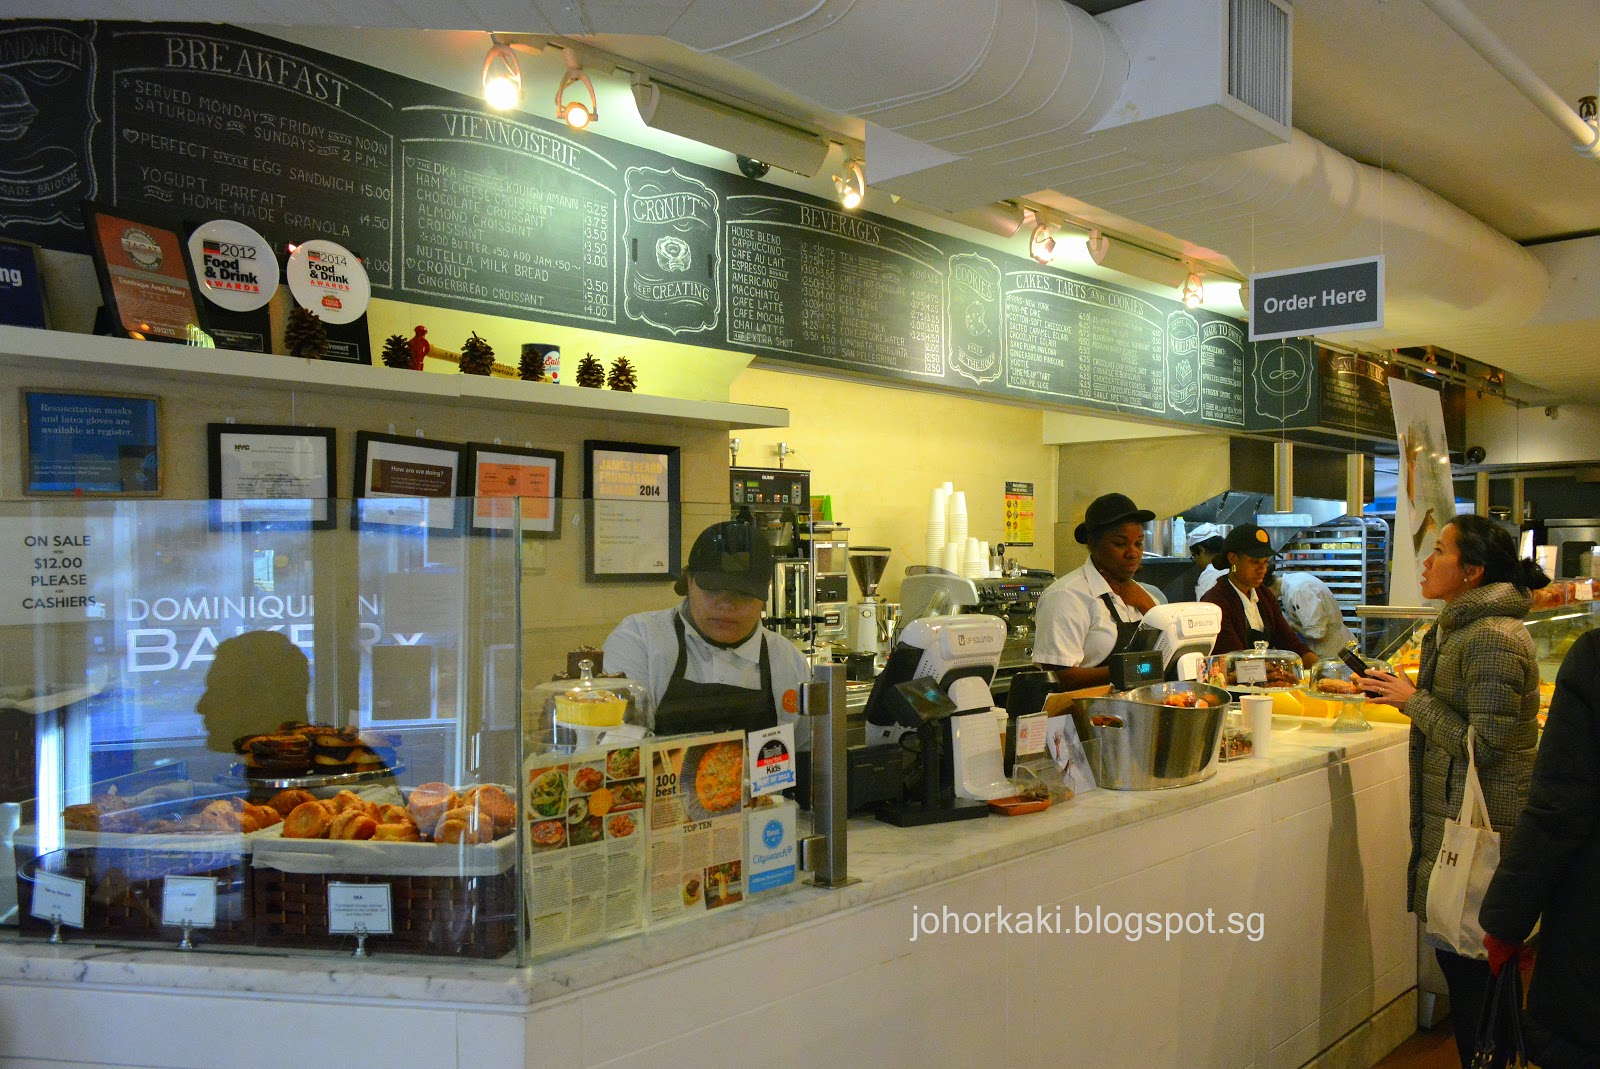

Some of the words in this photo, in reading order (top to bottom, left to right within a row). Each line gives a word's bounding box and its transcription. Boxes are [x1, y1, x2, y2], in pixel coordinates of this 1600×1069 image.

[165, 37, 349, 108] BREAKFAST
[135, 79, 191, 106] SERVED
[199, 97, 259, 124] MONDAY
[279, 117, 326, 140] FRIDAY
[356, 135, 388, 156] NOON
[135, 97, 223, 131] SATURDAYS
[254, 126, 316, 153] SUNDAYS
[342, 150, 351, 162] 2
[443, 113, 581, 171] VIENNOISERIE
[140, 132, 209, 160] PERFECT
[253, 159, 282, 177] EGG
[289, 167, 354, 195] SANDWICH
[360, 184, 391, 201] $5.00
[37, 168, 80, 195] BRIOCHE
[140, 165, 208, 193] YOGURT
[221, 183, 287, 208] PARFAIT
[433, 162, 457, 179] DKA
[546, 192, 579, 210] AMANN
[416, 172, 440, 189] HAM
[452, 181, 490, 203] CHEESE
[495, 193, 556, 217] CROISSANT
[416, 188, 481, 214] CHOCOLATE
[487, 204, 546, 228] CROISSANT
[284, 213, 350, 238] GRANOLA
[418, 203, 468, 224] ALMOND
[472, 214, 533, 237] CROISSANT
[418, 217, 486, 241] CROISSANT
[800, 206, 880, 245] BEVERAGES
[220, 243, 258, 262] 2012
[430, 233, 449, 247] ADD
[513, 250, 531, 263] ADD
[731, 237, 783, 257] CAPPUCCINO
[203, 254, 240, 272] Food
[308, 261, 336, 275] Food
[320, 253, 348, 267] 2014
[416, 244, 474, 266] NUTELLA
[480, 258, 509, 274] MILK
[514, 263, 549, 282] BREAD
[731, 259, 767, 276] ESPRESSO
[754, 252, 766, 265] AU
[767, 257, 786, 271] LAIT
[204, 265, 217, 279] &
[219, 267, 259, 286] Drink
[309, 269, 320, 280] &
[320, 270, 349, 286] Drink
[731, 273, 779, 290] AMERICANO
[955, 266, 992, 299] COOKIES
[205, 280, 260, 293] AWARDS
[310, 279, 351, 292] AWARDS
[417, 273, 489, 297] GINGERBREAD
[492, 286, 544, 307] CROISSANT
[633, 282, 652, 297] KEEP
[652, 281, 710, 301] CREATING
[731, 284, 781, 303] MACCHIATO
[1055, 279, 1086, 299] TARTS
[1107, 293, 1144, 315] COOKIES
[1263, 293, 1317, 314] Order
[1322, 288, 1367, 308] Here
[757, 310, 786, 325] MOCHA
[733, 319, 754, 331] CHAI
[757, 322, 785, 336] LATTE
[1219, 324, 1228, 337] TO
[747, 333, 773, 346] EXTRA
[776, 336, 795, 348] SHOT
[41, 403, 103, 415] Resuscitation
[104, 406, 133, 416] masks
[41, 414, 60, 424] and
[61, 415, 84, 425] latex
[86, 415, 114, 427] gloves
[116, 418, 131, 426] are
[41, 425, 84, 436] available
[86, 427, 96, 435] at
[391, 464, 405, 474] How
[425, 468, 444, 479] doing?
[600, 459, 632, 471] JAMES
[639, 484, 661, 497] 2014
[24, 534, 49, 548] ON
[53, 534, 92, 548] SALE
[34, 556, 84, 571] $12.00
[31, 573, 89, 587] PLEASE
[22, 594, 97, 610] CASHIERS
[766, 764, 782, 775] Kids
[656, 772, 677, 787] 100
[655, 784, 677, 799] best
[683, 822, 699, 834] TOP
[698, 819, 713, 831] TEN
